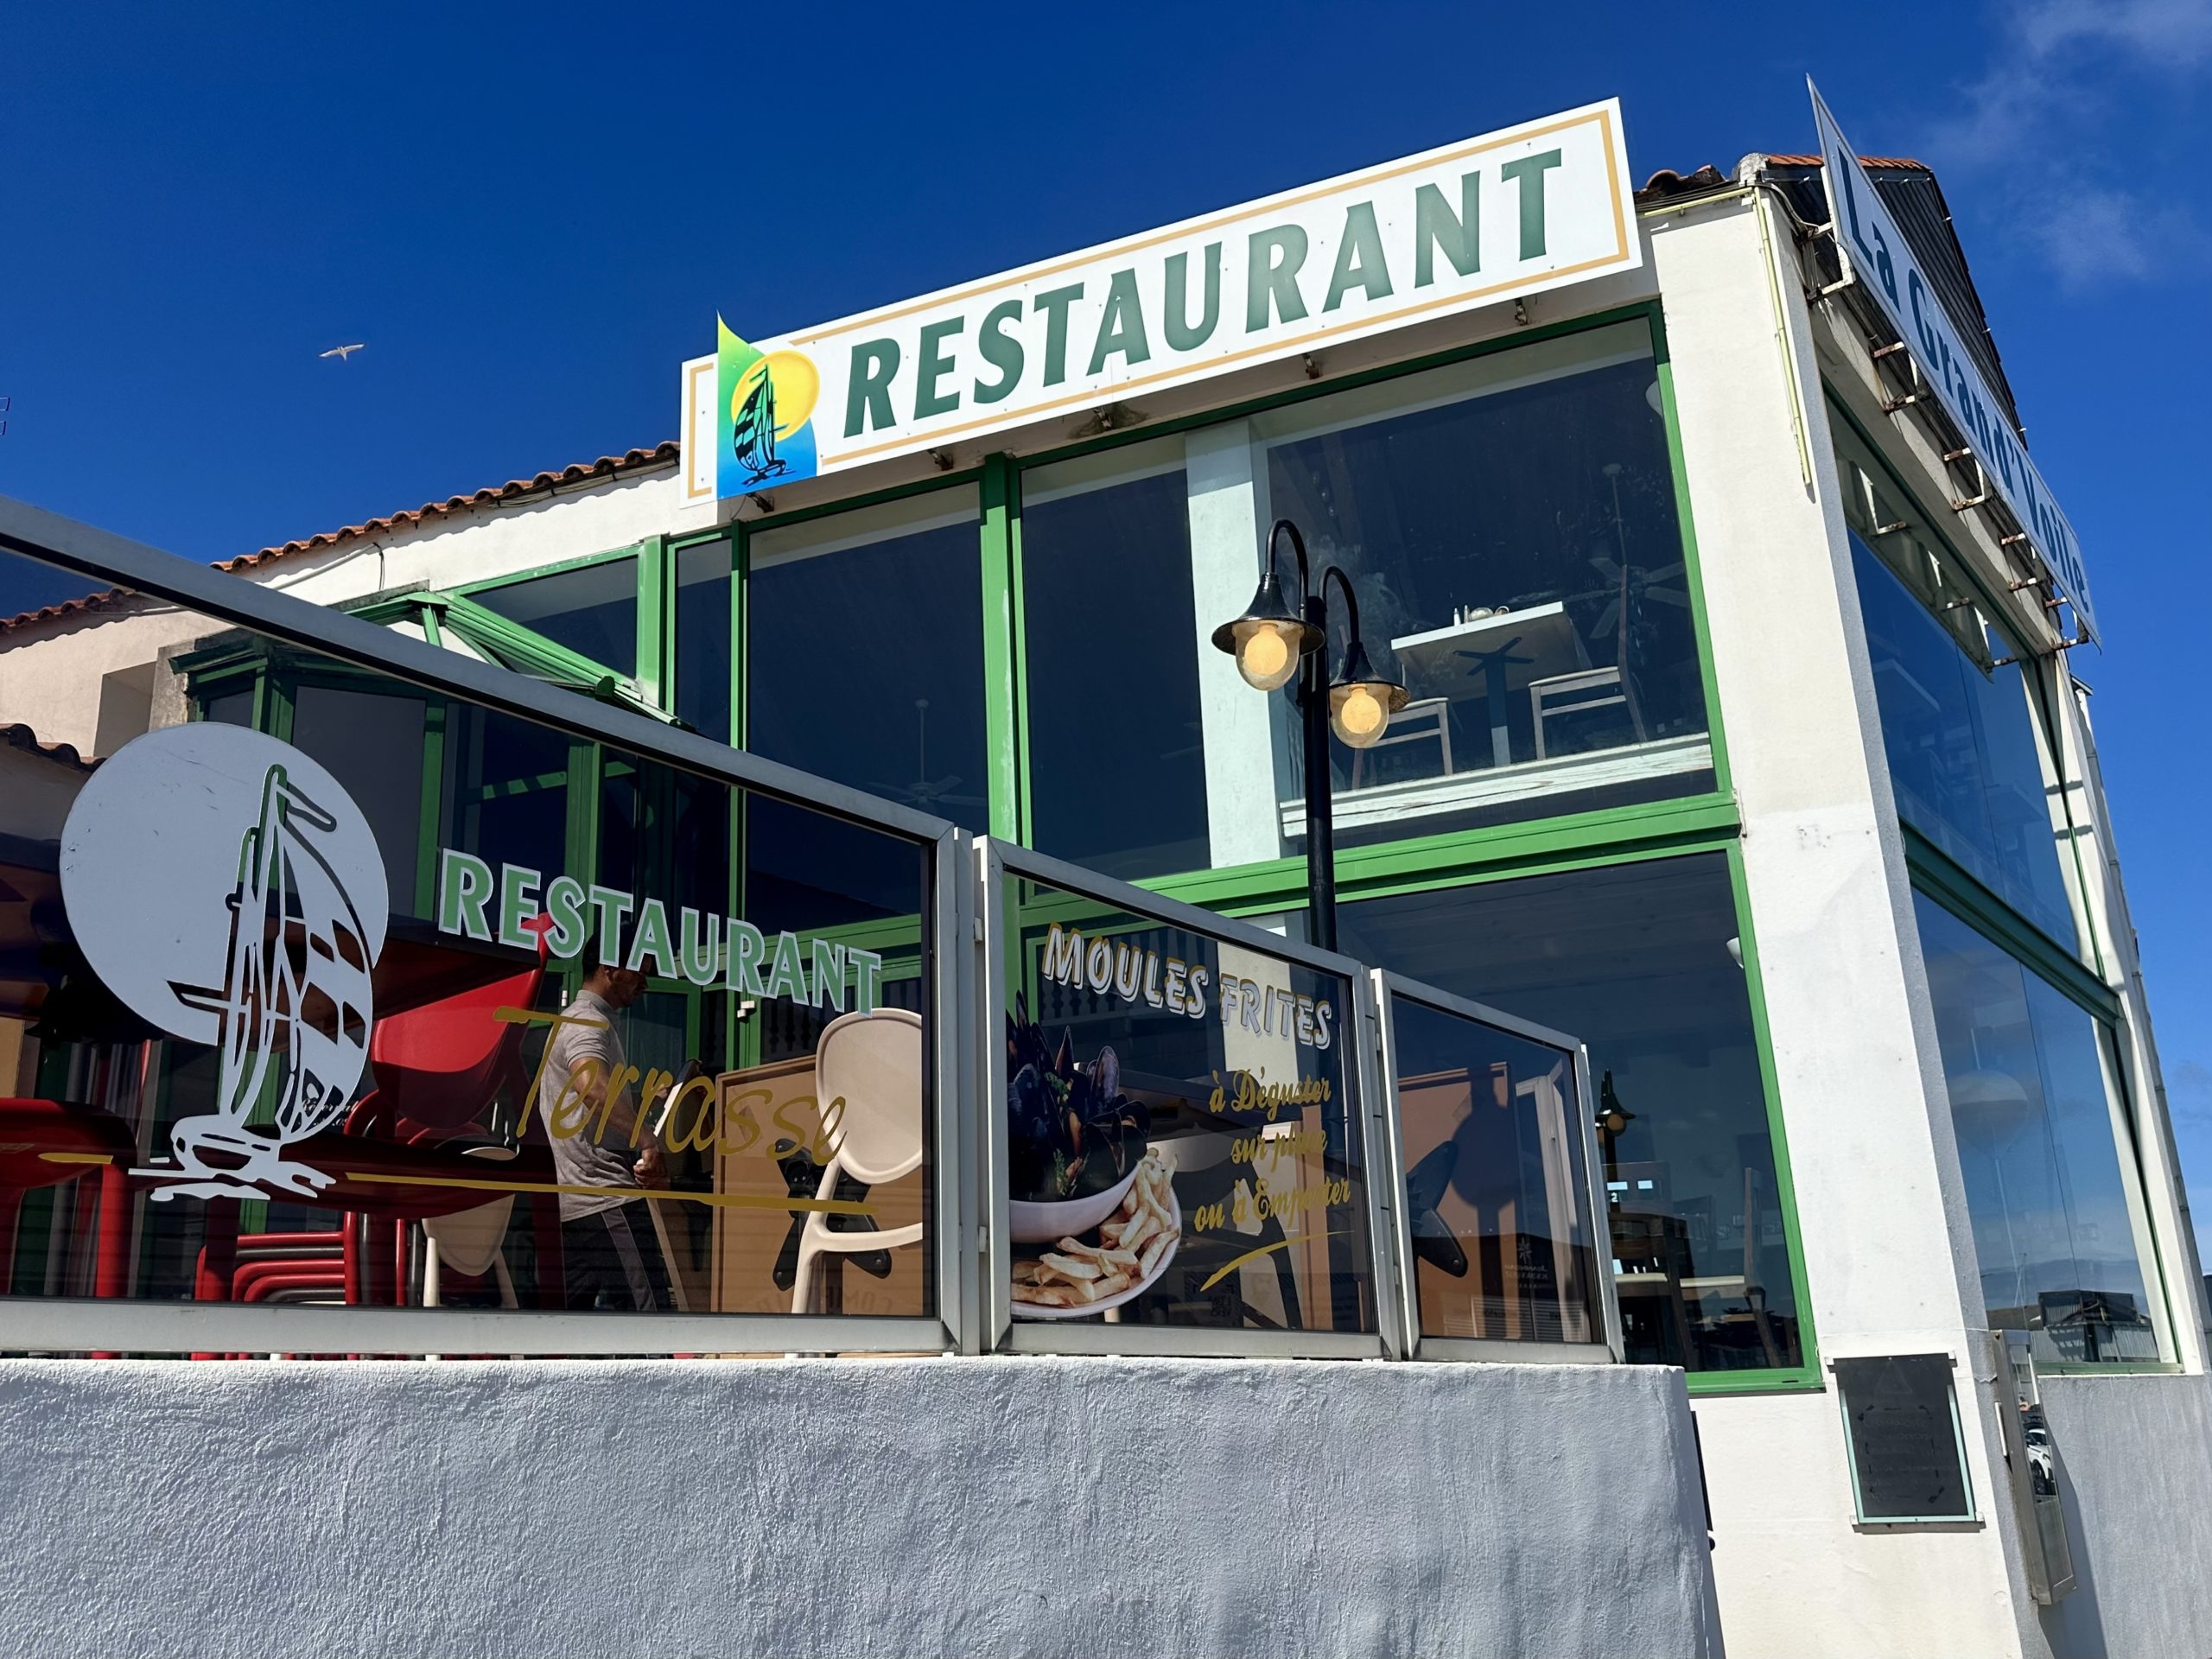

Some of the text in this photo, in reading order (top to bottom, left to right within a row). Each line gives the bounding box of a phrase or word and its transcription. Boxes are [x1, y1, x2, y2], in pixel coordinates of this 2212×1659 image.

[842, 149, 1562, 439] RESTAURANT
[1837, 144, 1901, 315] La
[438, 848, 881, 1018] RESTAURANT
[1041, 921, 1332, 1050] MOULES FRITES
[493, 1006, 849, 1166] Terrasse
[1210, 1066, 1332, 1122] à Déguster
[1230, 1134, 1268, 1164] sur
[1194, 1203, 1226, 1232] ou
[1232, 1179, 1247, 1224] à
